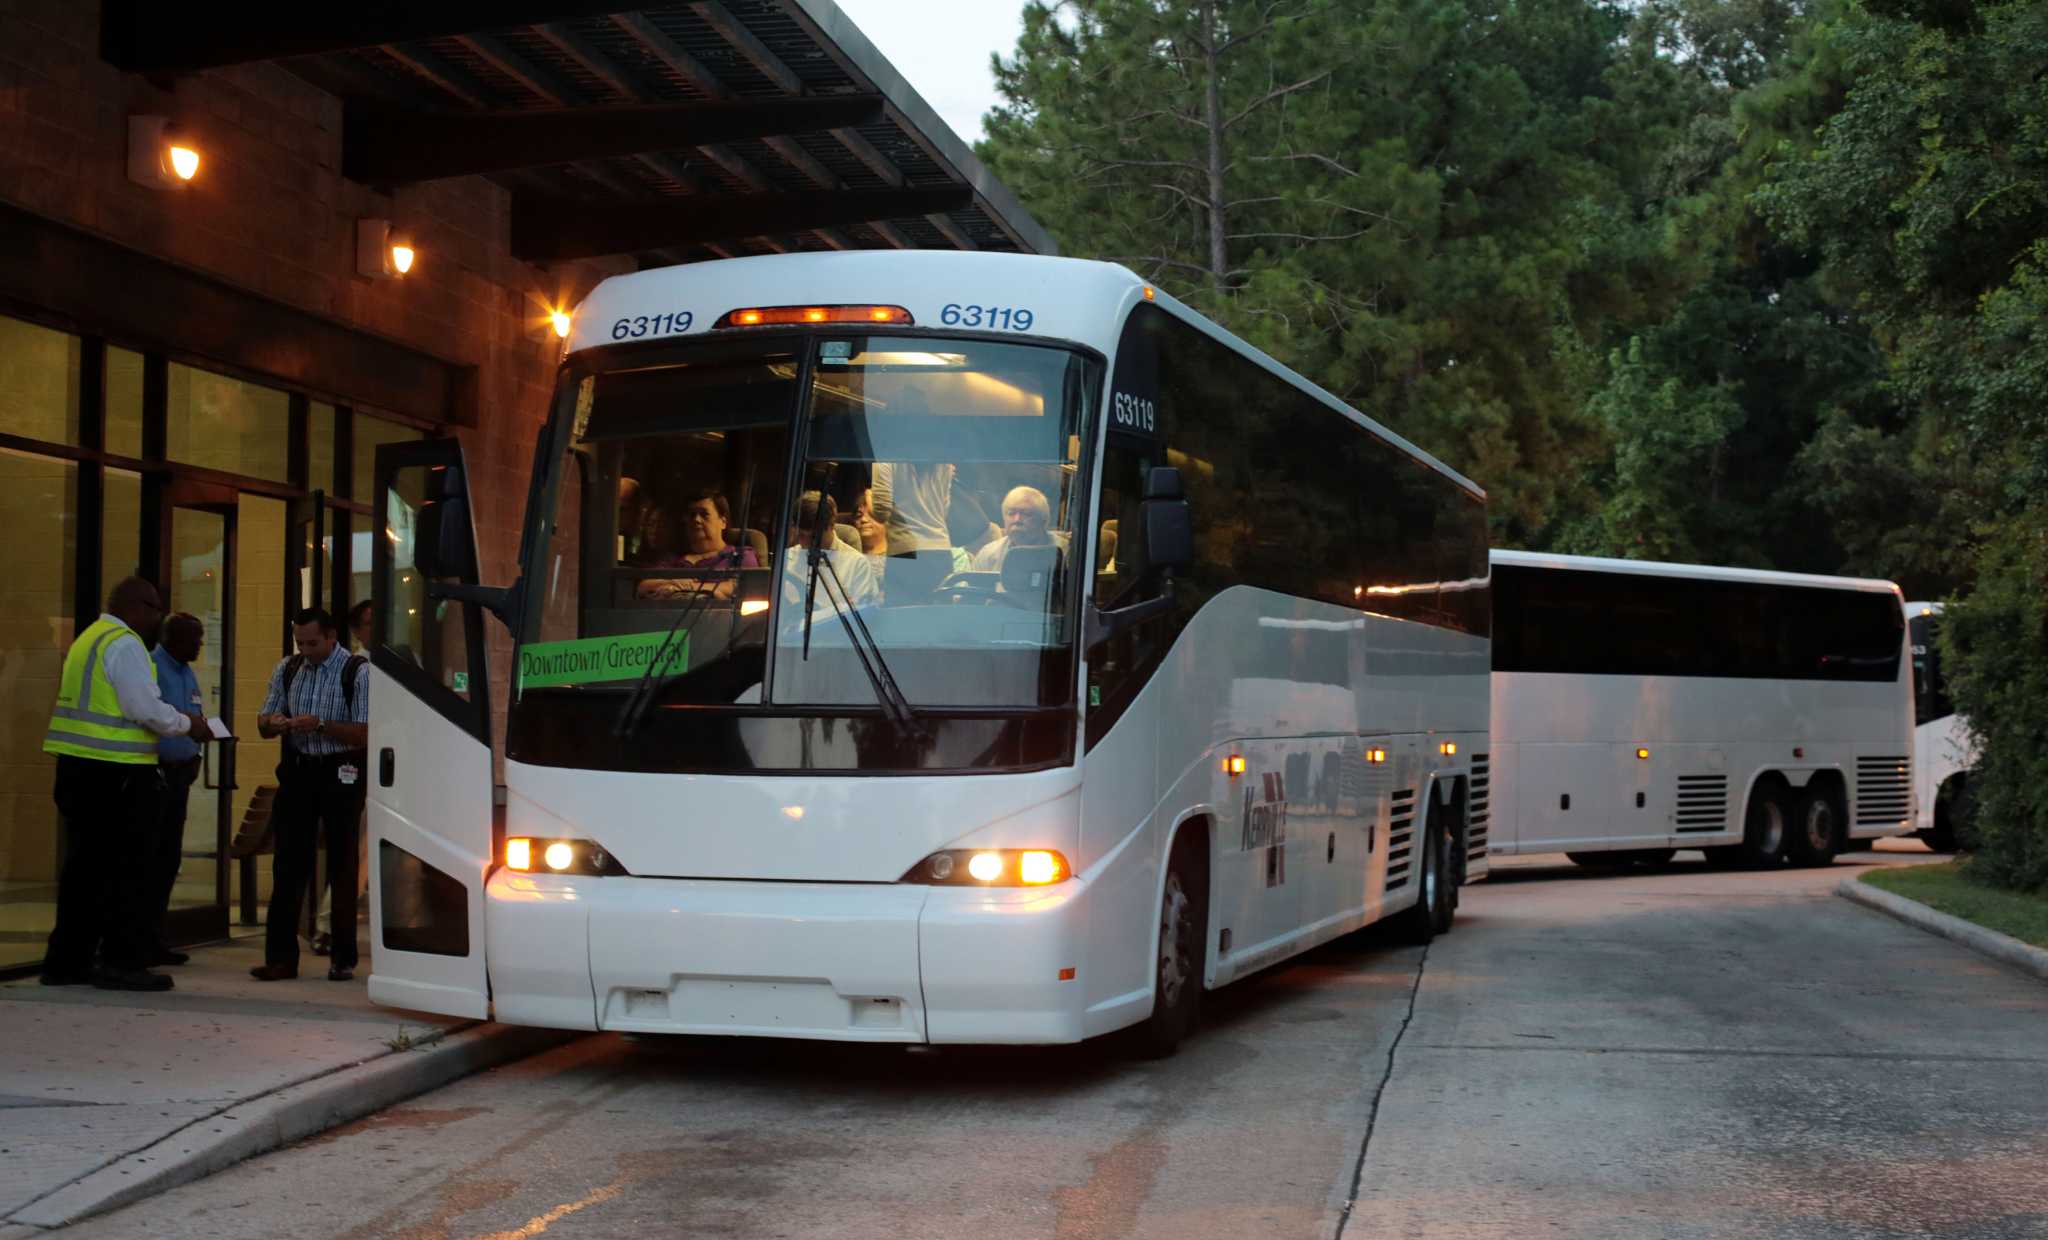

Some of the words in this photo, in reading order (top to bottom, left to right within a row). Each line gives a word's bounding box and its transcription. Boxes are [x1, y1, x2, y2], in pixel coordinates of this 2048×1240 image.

[612, 311, 693, 340] 63119
[941, 303, 1033, 331] 63119
[1115, 391, 1154, 432] 63119
